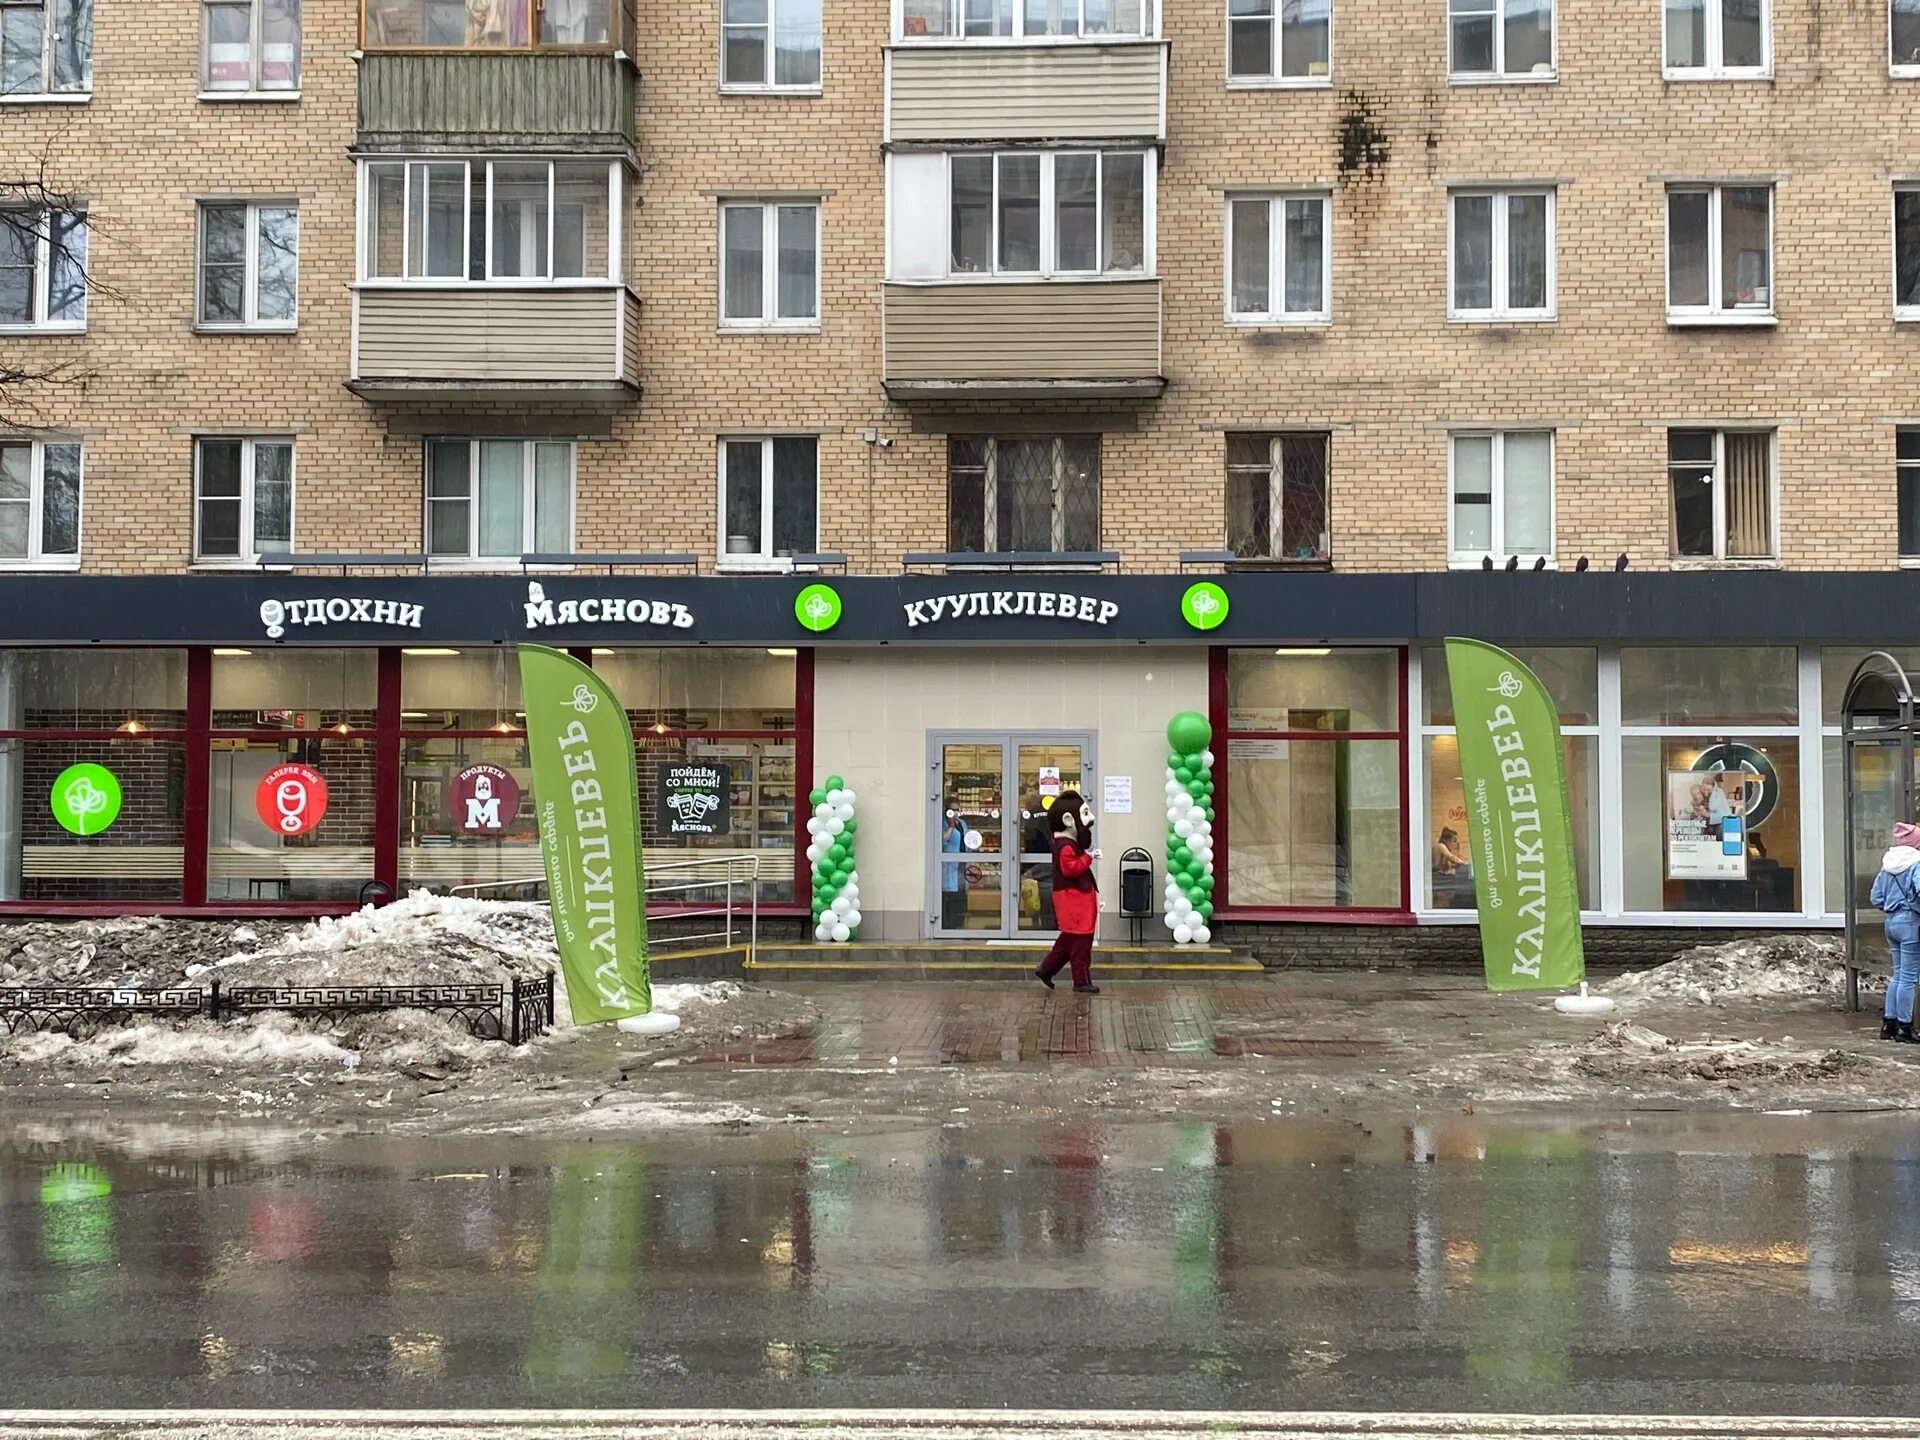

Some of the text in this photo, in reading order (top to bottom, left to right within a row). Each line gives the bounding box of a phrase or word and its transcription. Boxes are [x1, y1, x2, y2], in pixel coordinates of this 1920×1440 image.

[903, 590, 1119, 628] КУУЛКЛЕВЕР
[265, 766, 319, 785] ГАЛЕРЕЯ ВИН
[460, 765, 506, 781] ПРОДУКТЫ
[670, 766, 717, 778] ПОЙДЁМ
[665, 775, 720, 788] СО МНОЙ!
